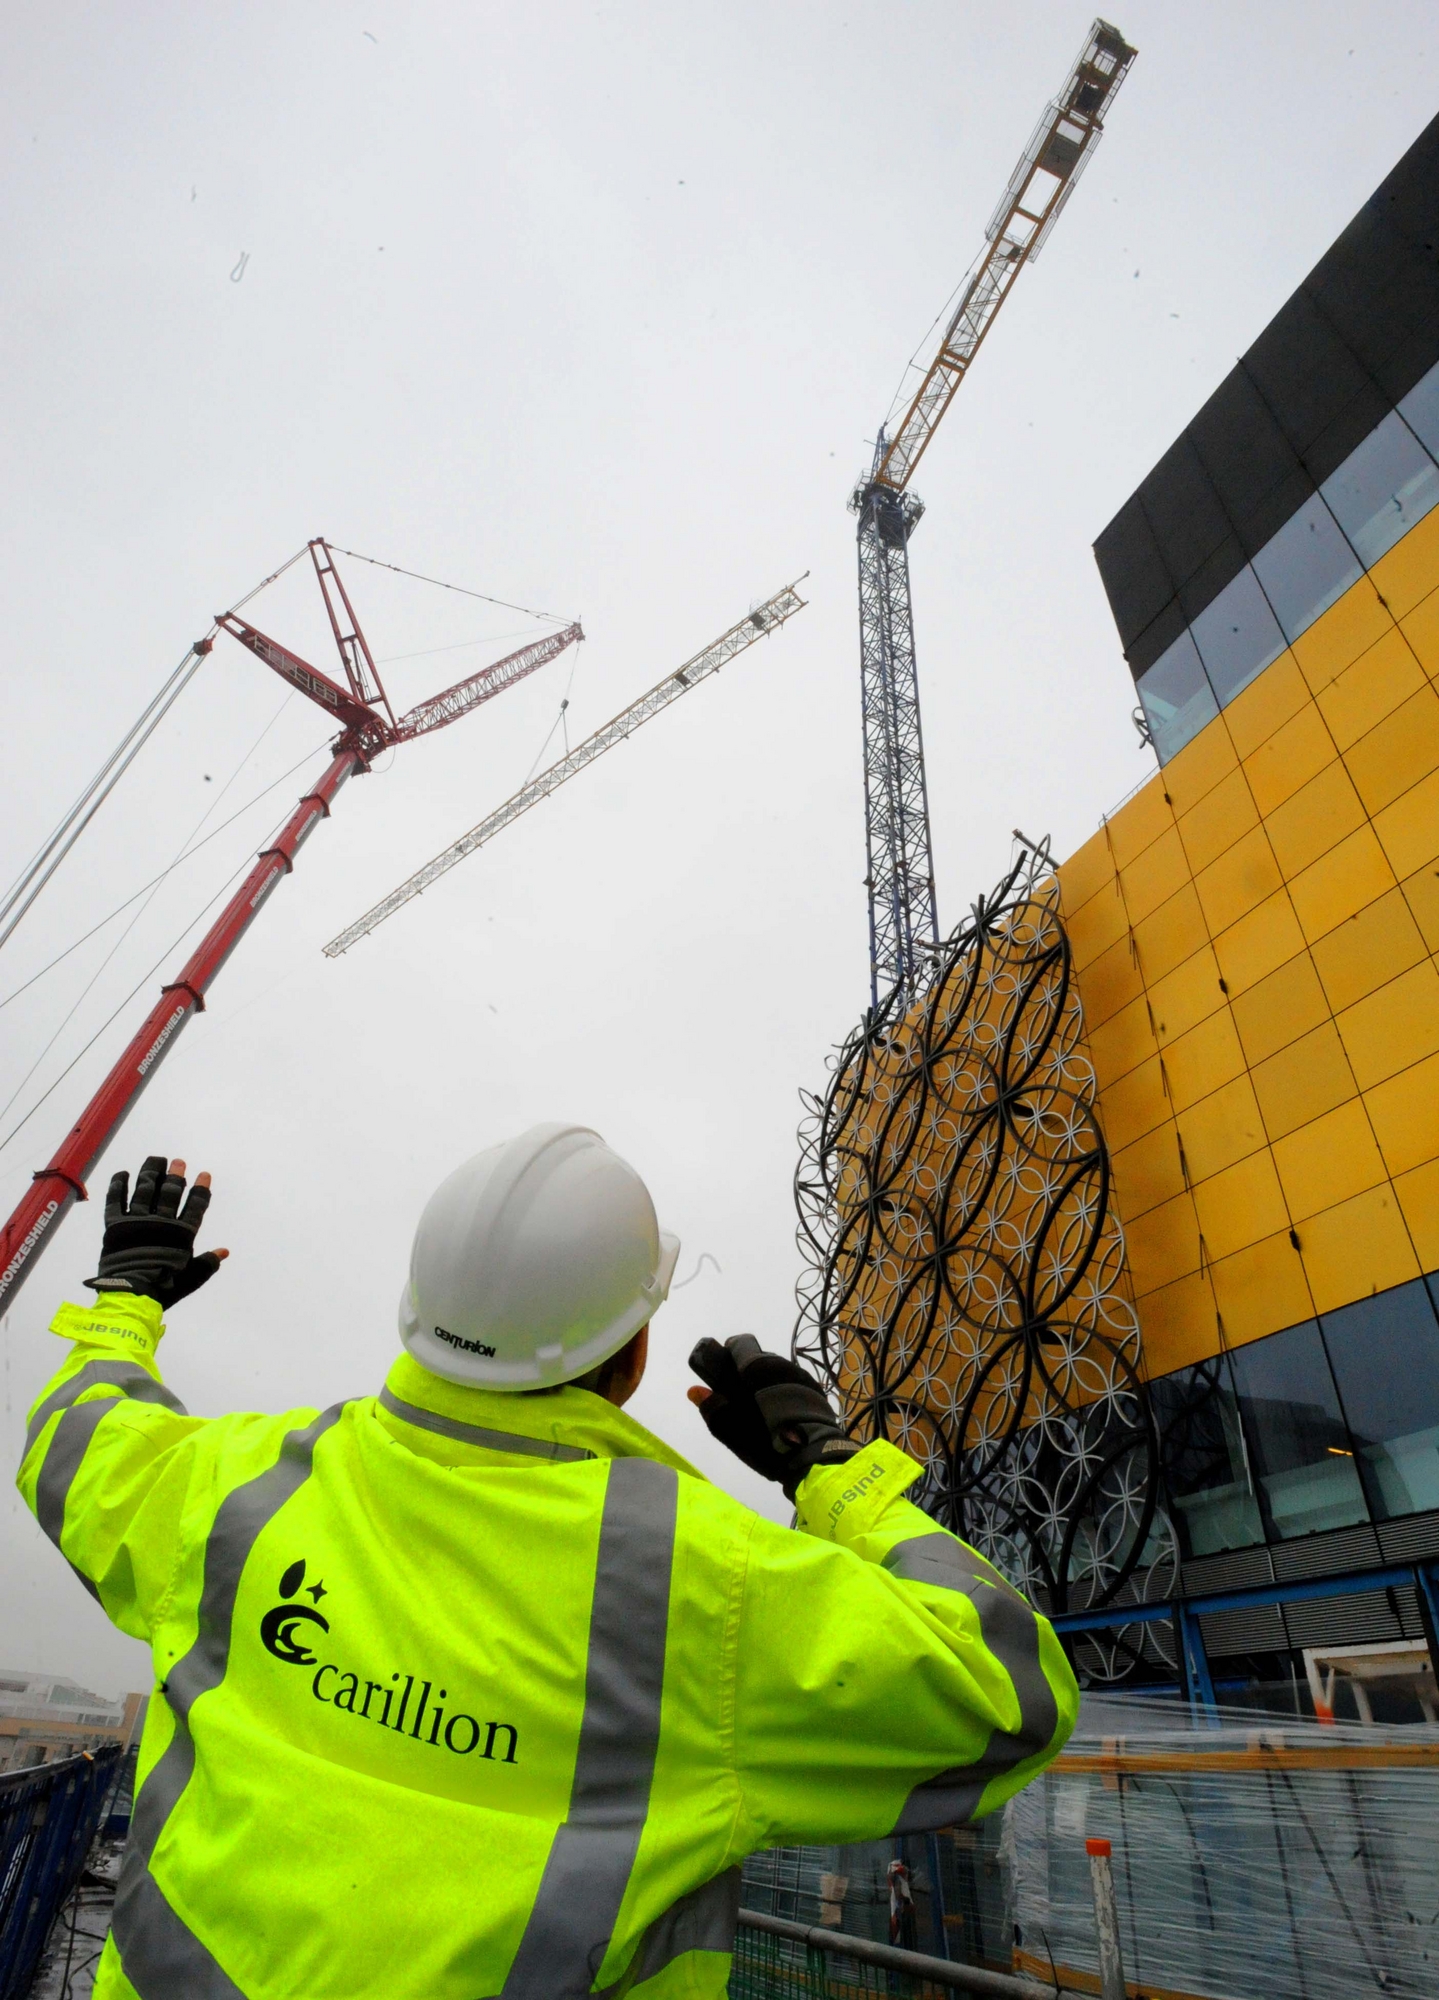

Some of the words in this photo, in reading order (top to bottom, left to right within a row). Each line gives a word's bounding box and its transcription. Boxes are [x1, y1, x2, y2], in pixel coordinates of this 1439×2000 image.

[137, 1005, 185, 1075] BRONZESHIELD
[0, 1200, 59, 1298] RONZESHIELD
[312, 1664, 519, 1764] carillion
